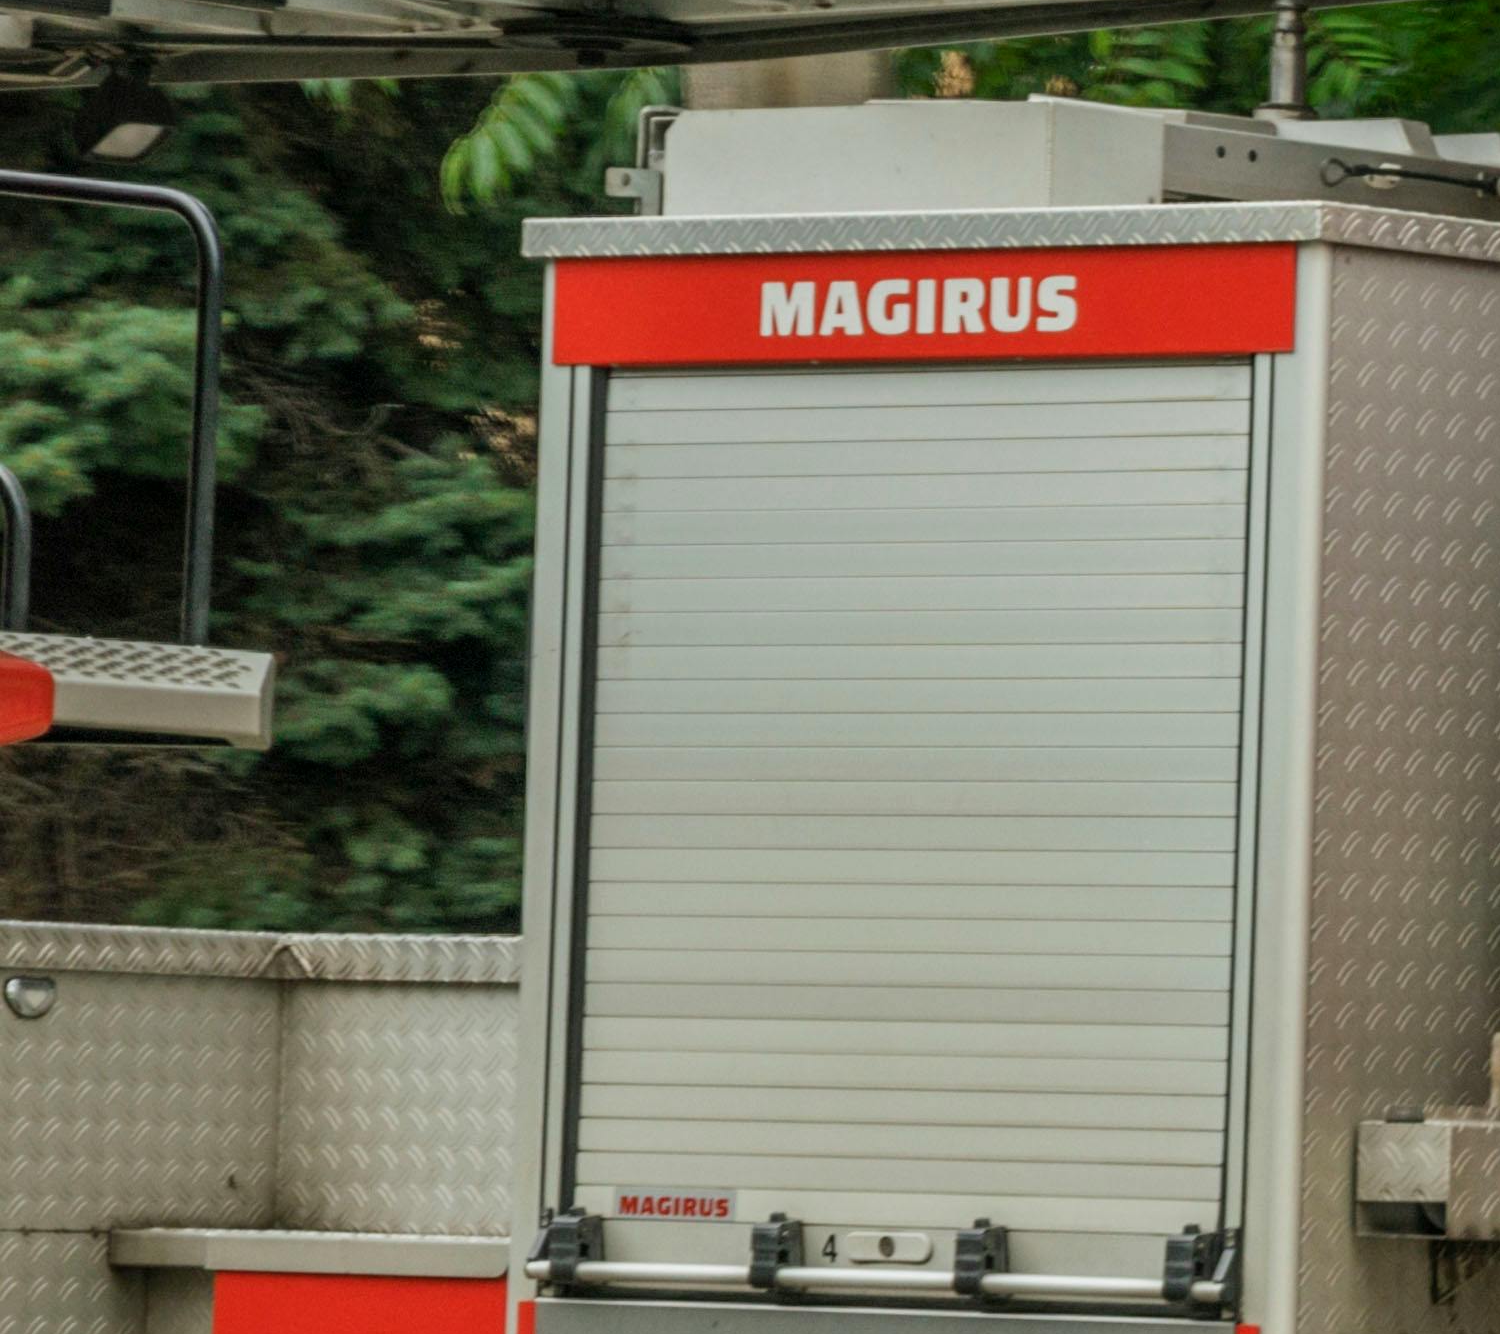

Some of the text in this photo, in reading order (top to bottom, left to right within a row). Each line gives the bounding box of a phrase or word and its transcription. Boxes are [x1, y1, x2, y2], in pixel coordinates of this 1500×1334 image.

[759, 274, 1079, 338] MAGIRUS
[619, 1194, 730, 1218] MAGIRUS
[822, 1233, 838, 1264] 4
